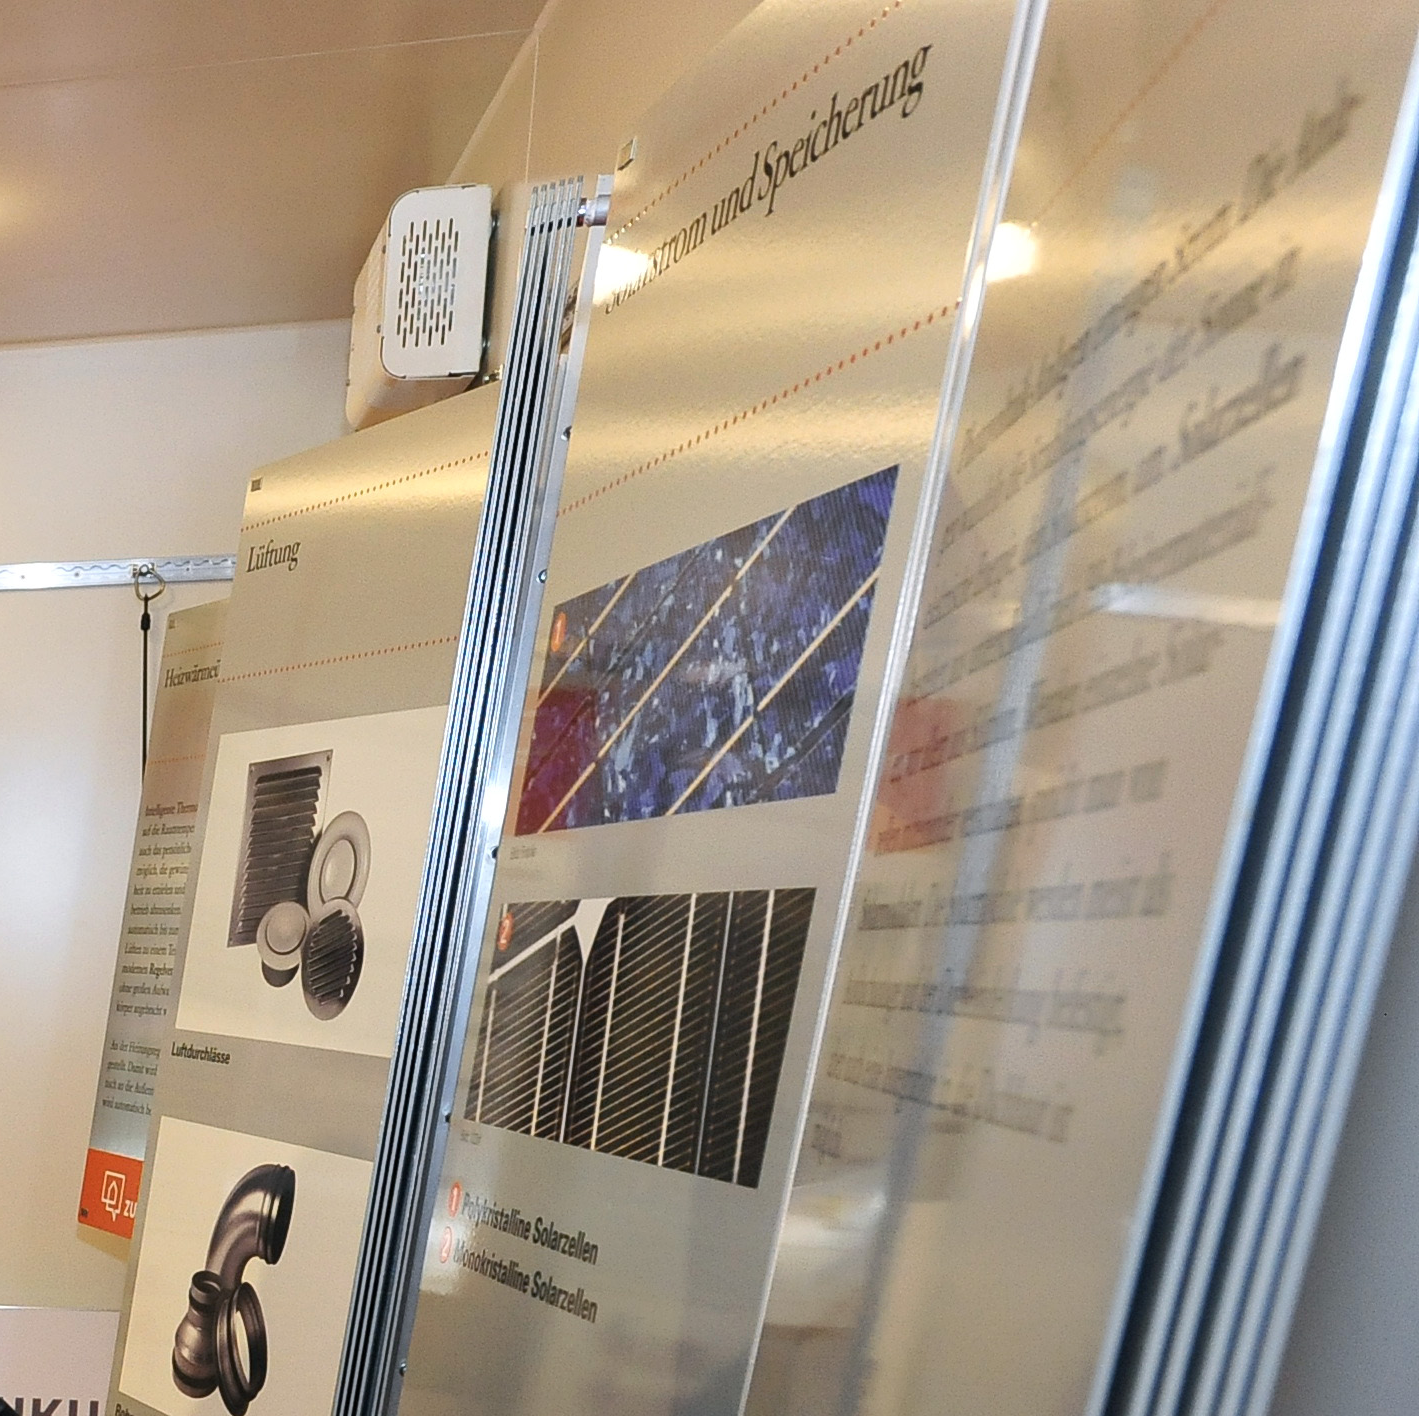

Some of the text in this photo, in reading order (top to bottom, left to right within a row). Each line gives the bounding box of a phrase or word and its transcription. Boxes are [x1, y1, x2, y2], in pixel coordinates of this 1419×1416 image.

[709, 151, 760, 236] und
[759, 44, 932, 217] Speicherung
[246, 539, 301, 573] Lüftung
[164, 659, 221, 688] Heizwärmeü
[171, 1041, 231, 1065] Luftdurchlässe
[532, 1216, 599, 1266] Solarzellen
[531, 1271, 598, 1324] Solarzellen
